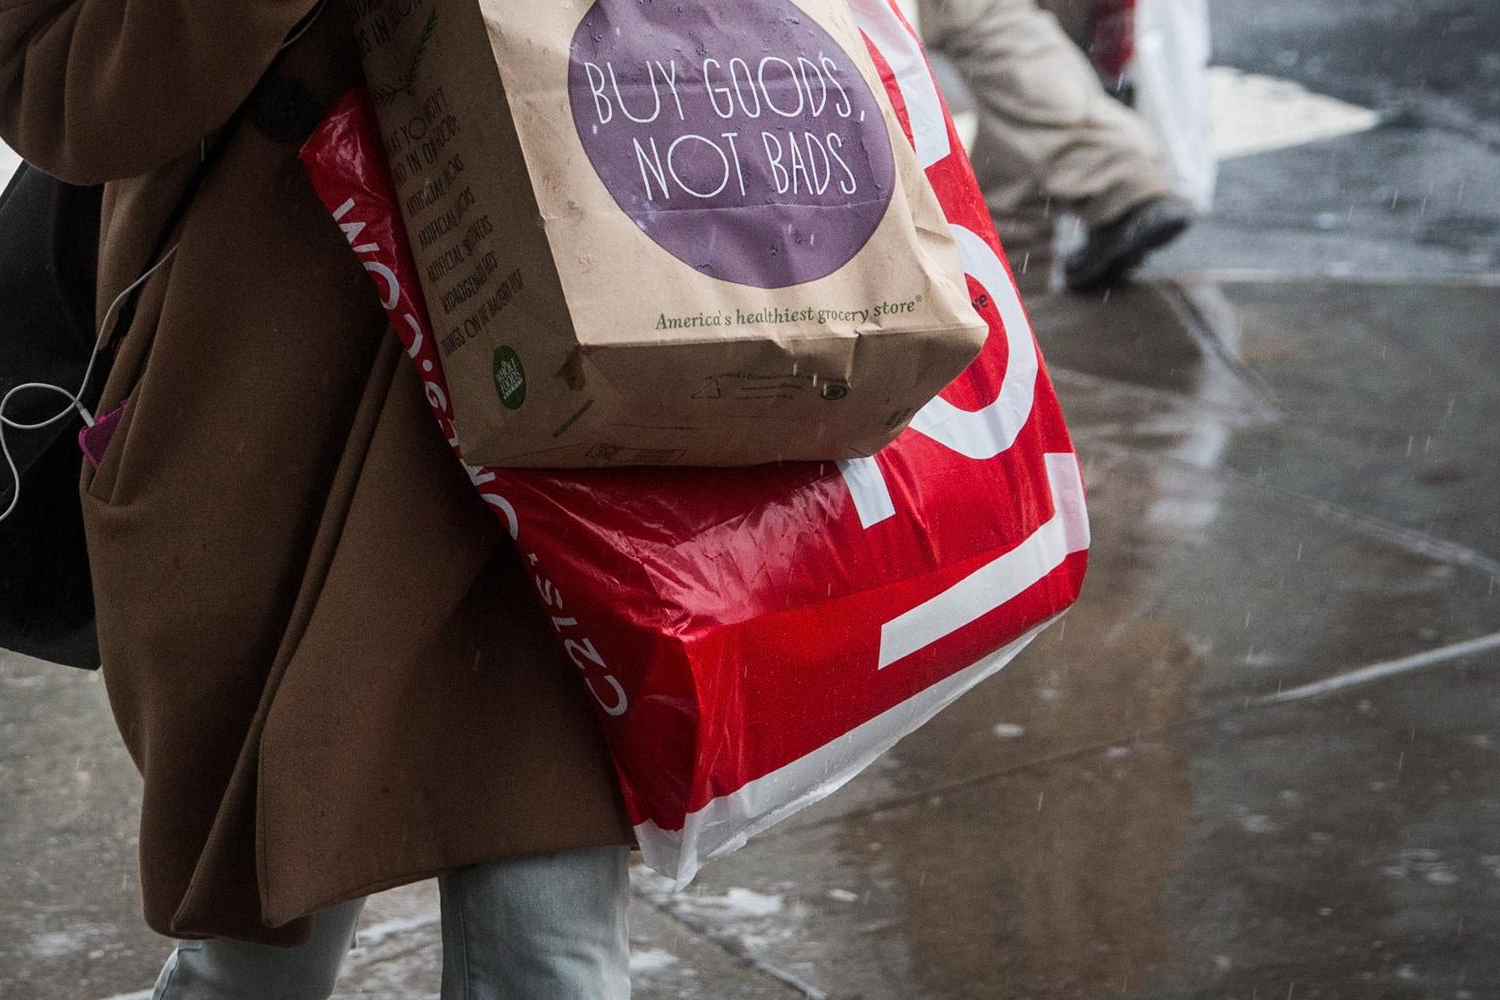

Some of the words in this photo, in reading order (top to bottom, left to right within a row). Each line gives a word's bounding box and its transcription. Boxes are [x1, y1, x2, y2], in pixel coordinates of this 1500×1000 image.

[584, 60, 684, 124] BUY
[703, 56, 865, 122] GOODS,
[632, 131, 746, 201] NOT
[761, 131, 857, 195] BADS
[406, 176, 447, 220] ARTIFICIAL
[418, 209, 459, 250] ARTIFICIAL
[426, 243, 465, 284] ARTIFICIAL
[655, 309, 732, 331] America's
[736, 305, 815, 326] healthiest
[817, 308, 869, 325] grocery
